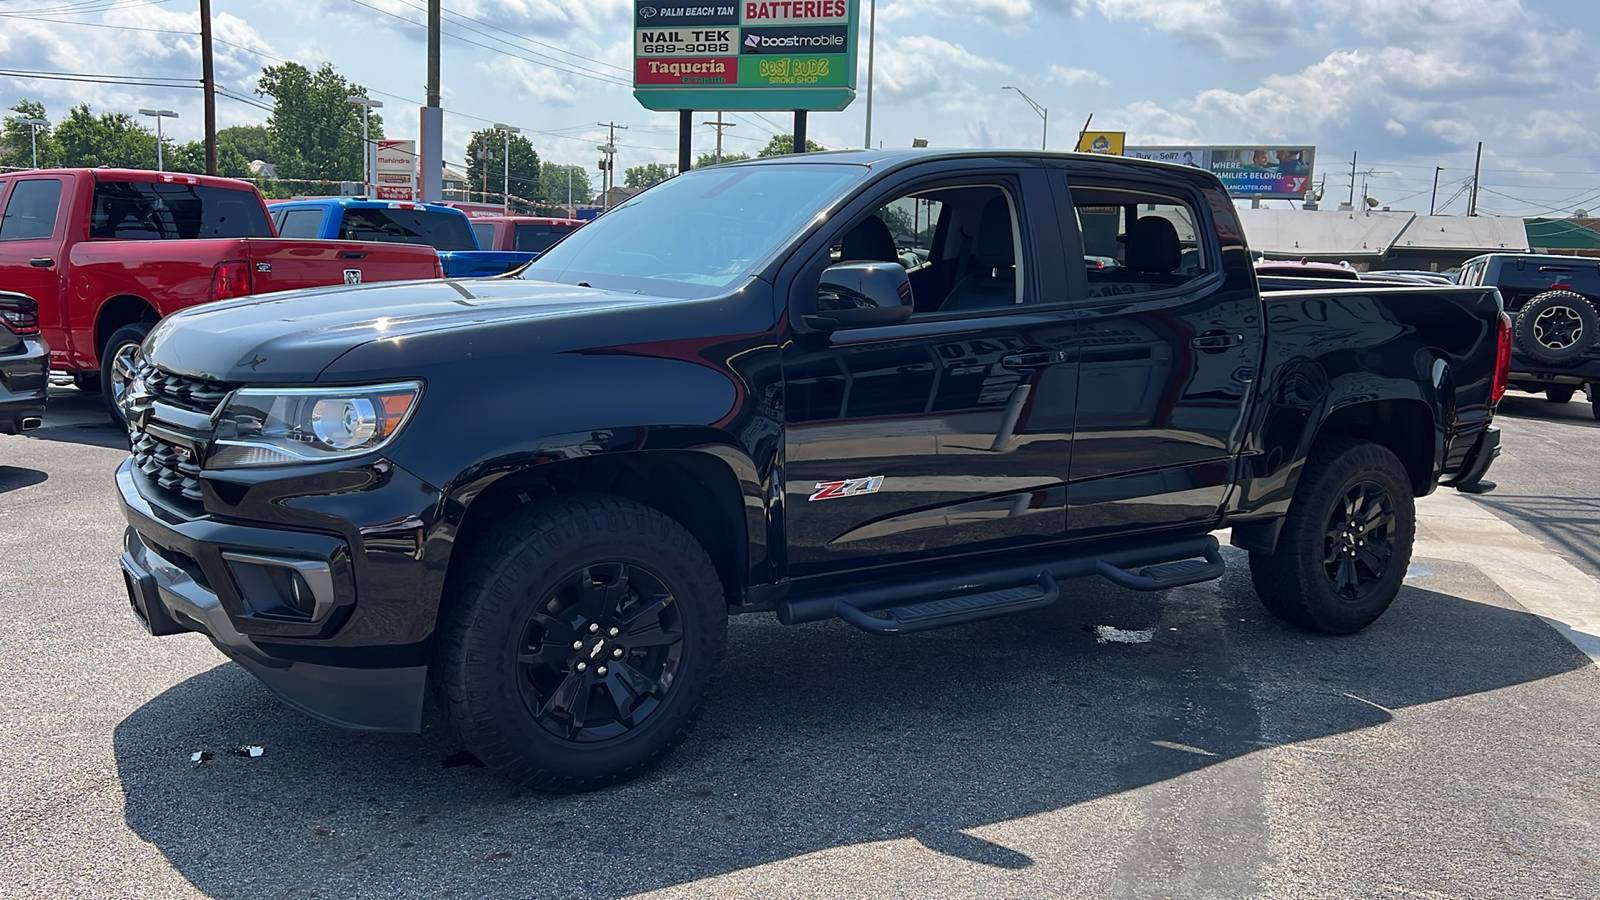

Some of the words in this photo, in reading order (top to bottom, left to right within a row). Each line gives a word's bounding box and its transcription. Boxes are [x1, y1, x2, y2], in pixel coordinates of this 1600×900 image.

[660, 7, 684, 17] PALM
[685, 7, 715, 16] BEACH
[717, 6, 735, 16] TAN
[746, 0, 846, 19] BATTERIES
[642, 31, 684, 43] NAIL
[691, 30, 731, 42] TEK
[643, 43, 729, 53] 689-9088
[769, 76, 796, 84] SMOKE
[796, 76, 818, 84] SHOP
[1159, 152, 1179, 160] Sell?
[1249, 172, 1285, 180] BELONG.
[808, 475, 885, 501] Z71
